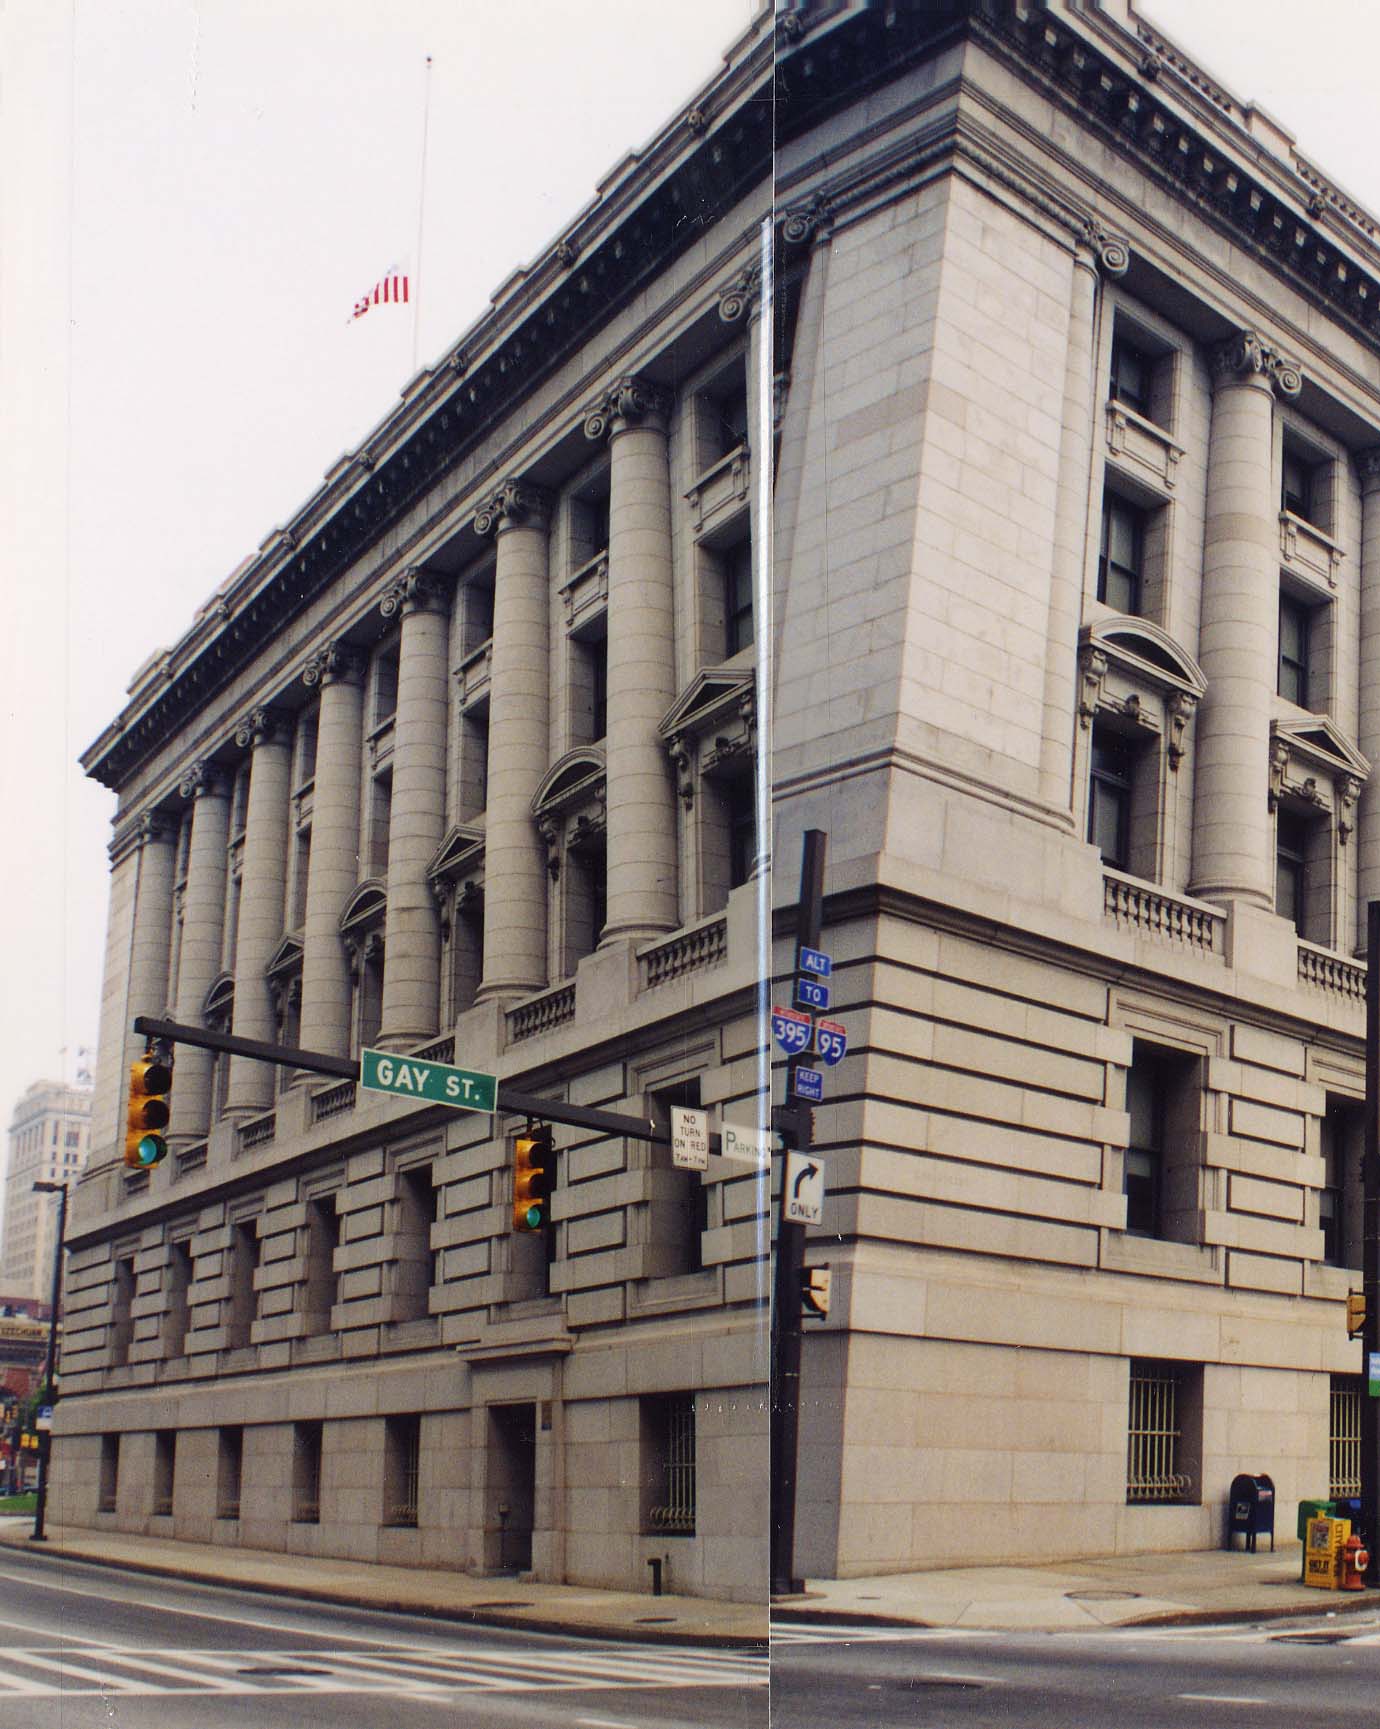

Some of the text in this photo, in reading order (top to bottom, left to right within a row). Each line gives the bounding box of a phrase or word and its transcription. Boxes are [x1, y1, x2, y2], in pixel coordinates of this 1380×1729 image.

[806, 954, 825, 972] ALT
[806, 985, 821, 1002] TO
[776, 1020, 806, 1047] 395
[820, 1033, 841, 1058] 95
[377, 1059, 480, 1100] GAY ST.
[799, 1071, 820, 1083] KEEP
[797, 1083, 820, 1098] RIGHT
[683, 1114, 696, 1125] NO
[680, 1126, 701, 1137] TURN
[674, 1138, 706, 1151] ON RED
[791, 1202, 818, 1219] ONLY
